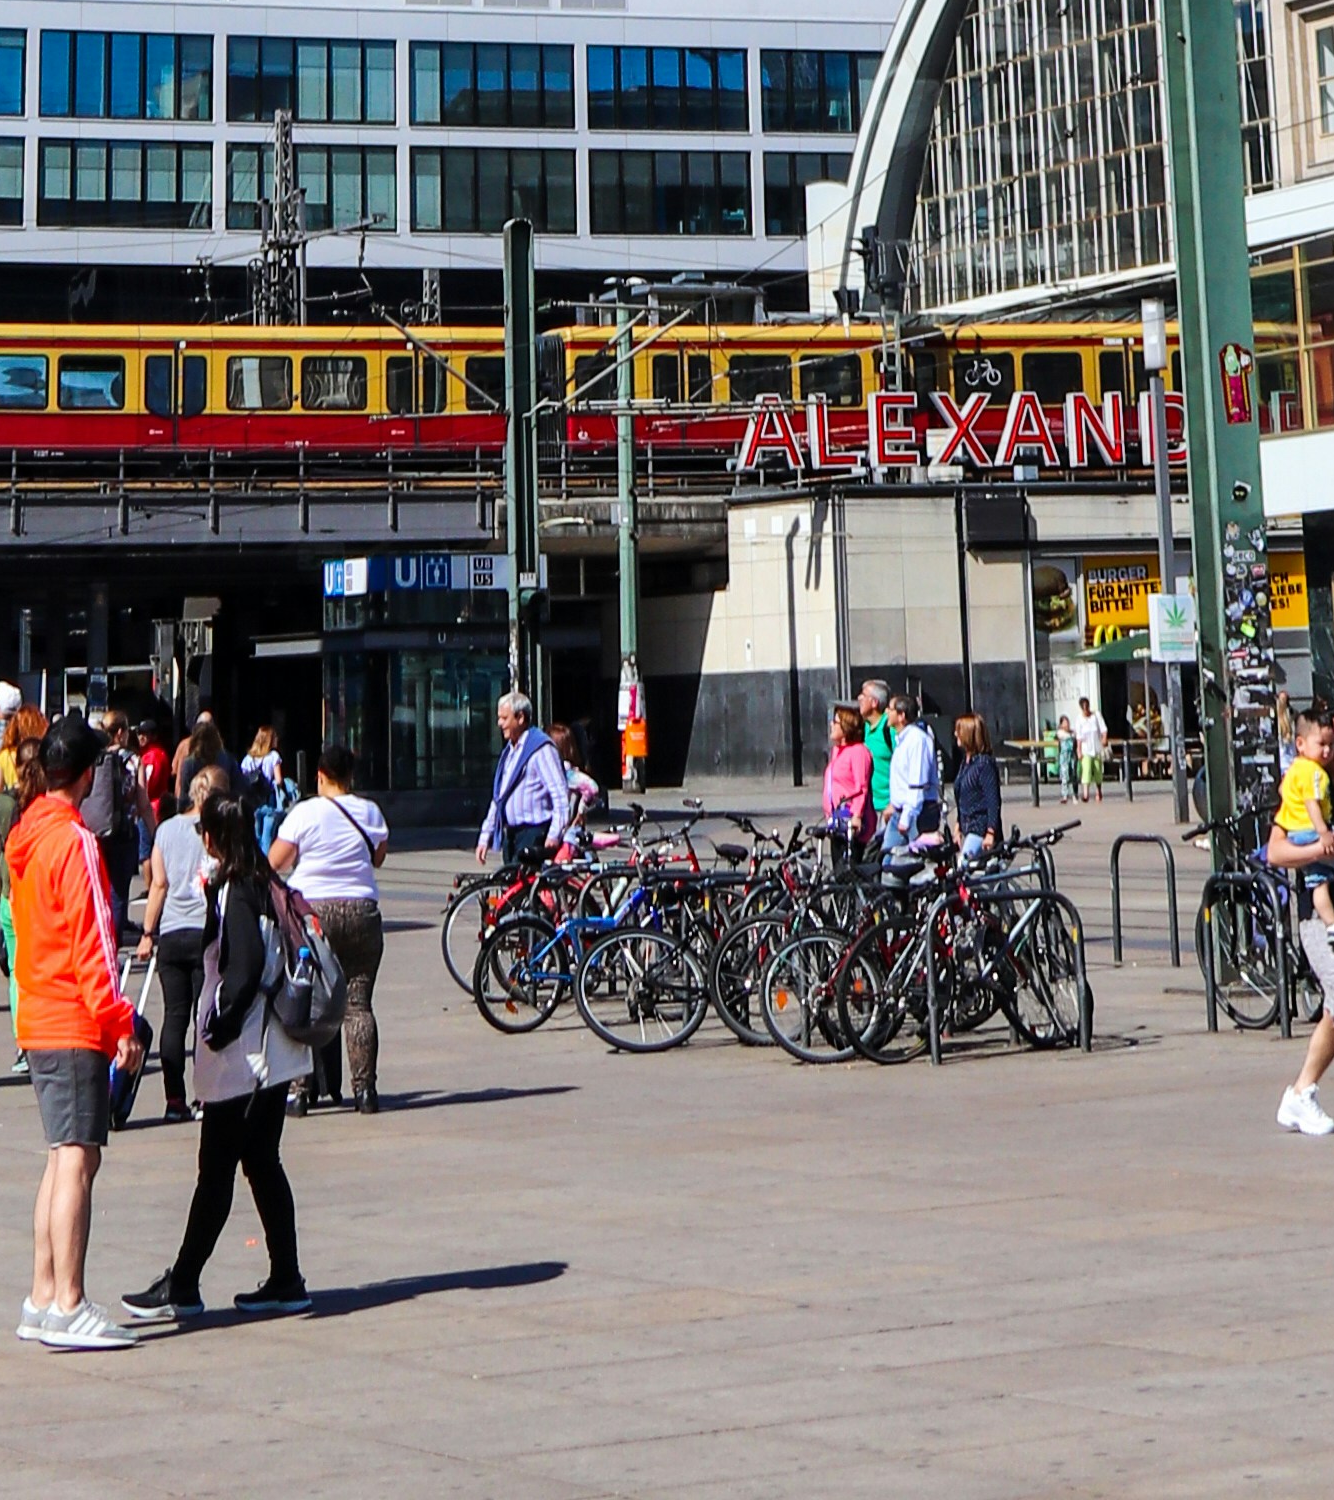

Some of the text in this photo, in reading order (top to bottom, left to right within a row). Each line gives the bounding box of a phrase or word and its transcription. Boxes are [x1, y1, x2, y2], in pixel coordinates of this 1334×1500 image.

[474, 557, 492, 569] U8
[324, 560, 335, 594] U
[394, 556, 417, 588] U
[475, 573, 492, 585] U5
[1088, 565, 1147, 584] BURGER
[1268, 572, 1289, 585] ICH
[1088, 581, 1116, 601] FÜR
[1270, 583, 1303, 598] LIEBE
[1090, 598, 1135, 615] BITTE!
[1271, 597, 1290, 610] ES!
